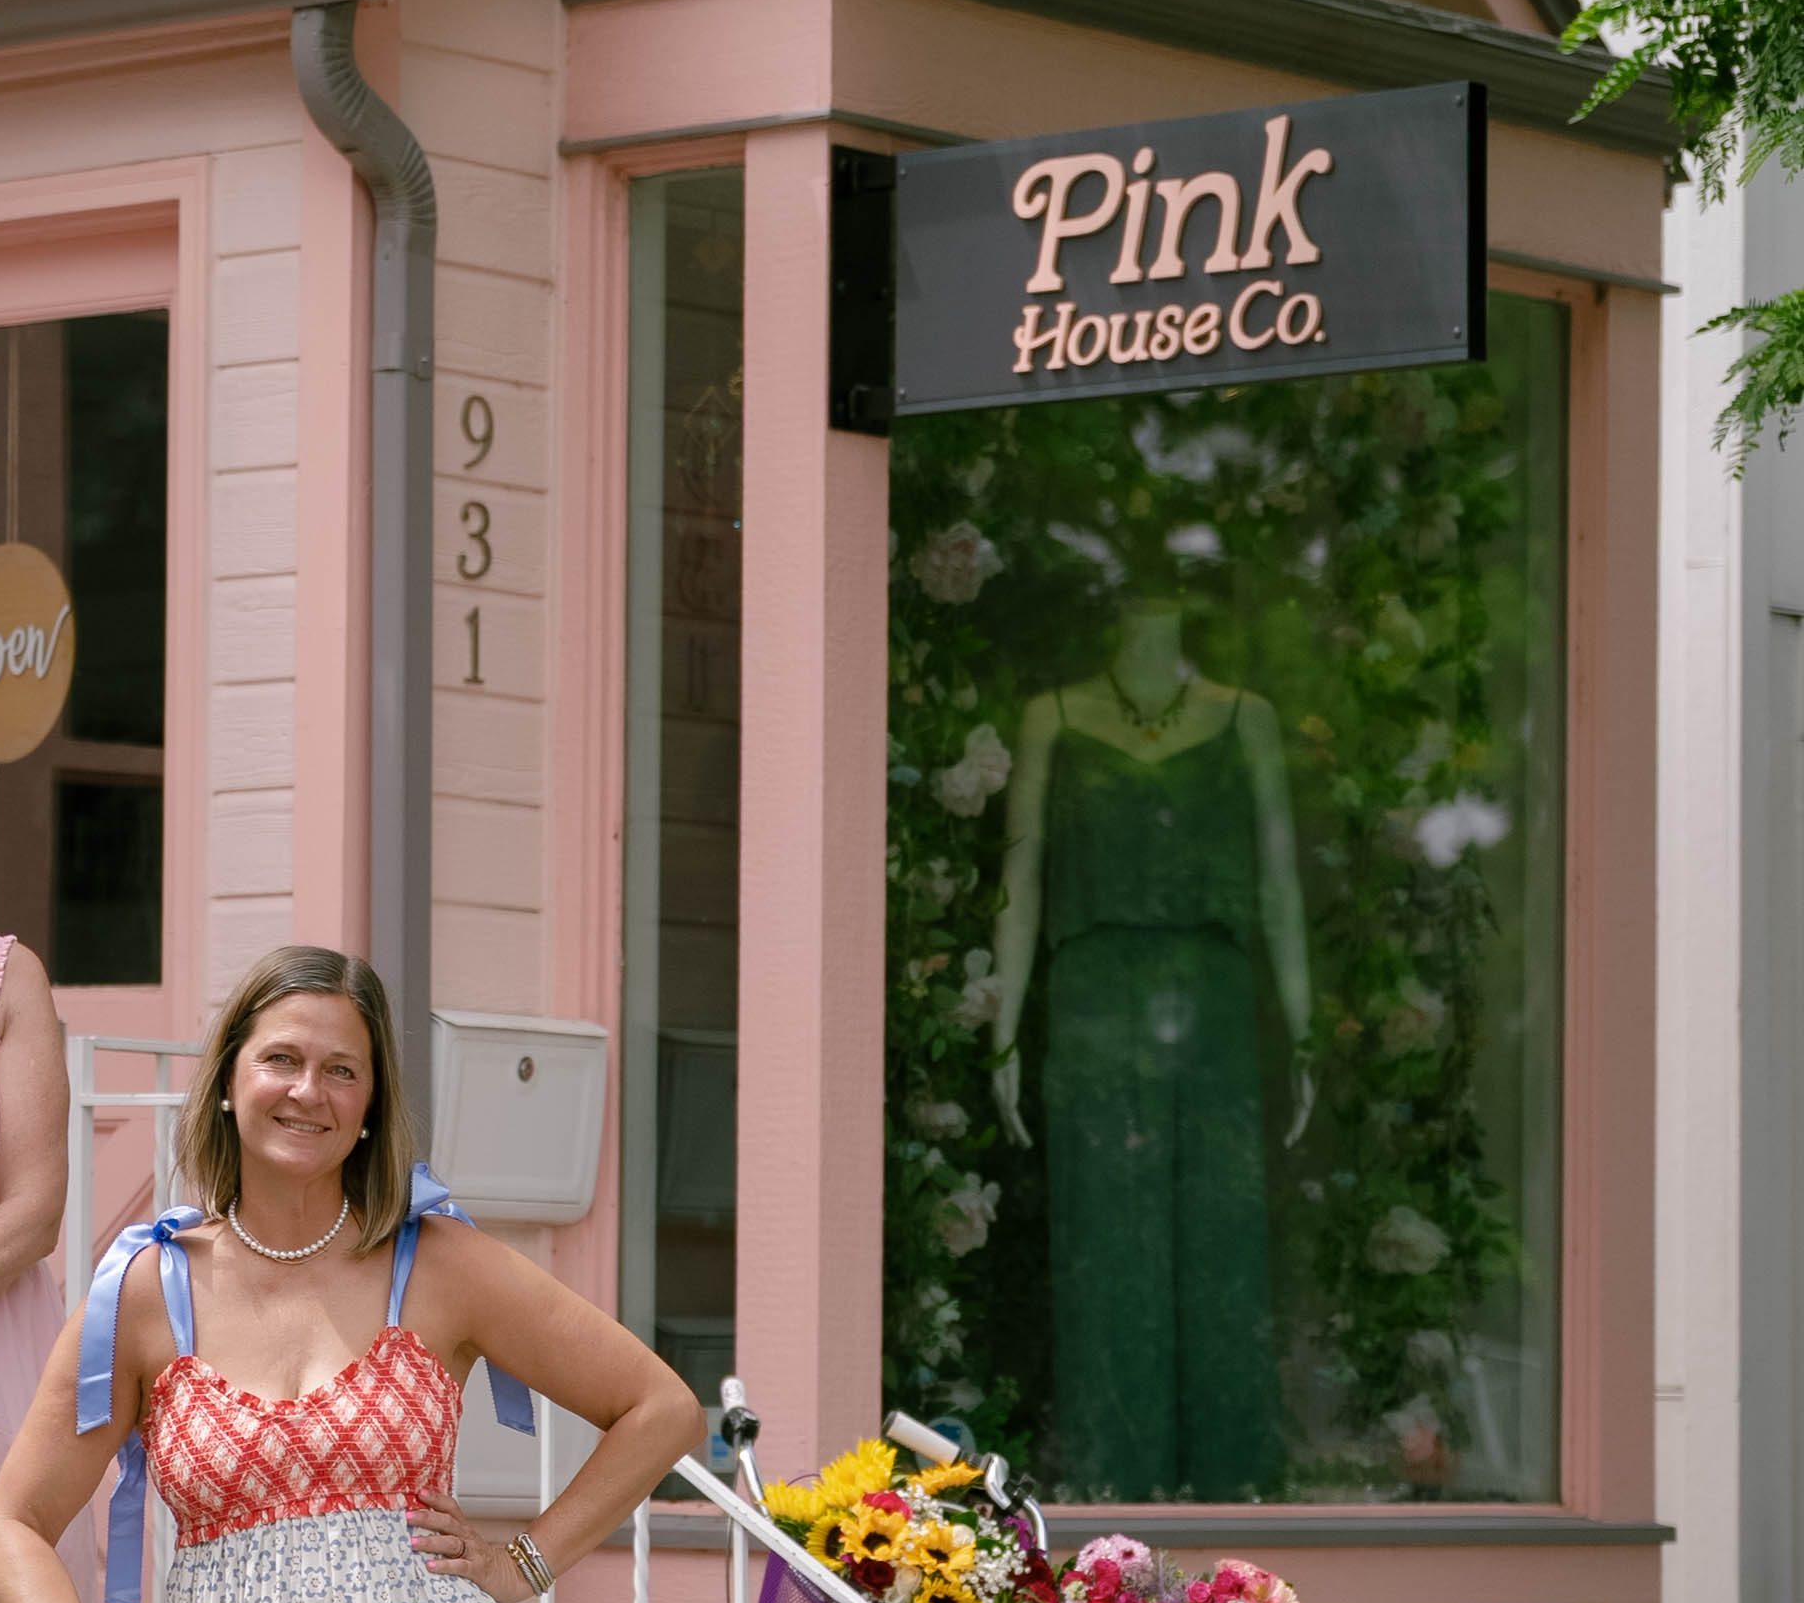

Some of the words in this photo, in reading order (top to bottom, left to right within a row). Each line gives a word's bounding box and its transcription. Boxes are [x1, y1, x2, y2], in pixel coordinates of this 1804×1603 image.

[1012, 113, 1334, 294] Pink
[1012, 300, 1221, 374] House
[1229, 279, 1327, 351] Co.
[456, 394, 494, 685] 931
